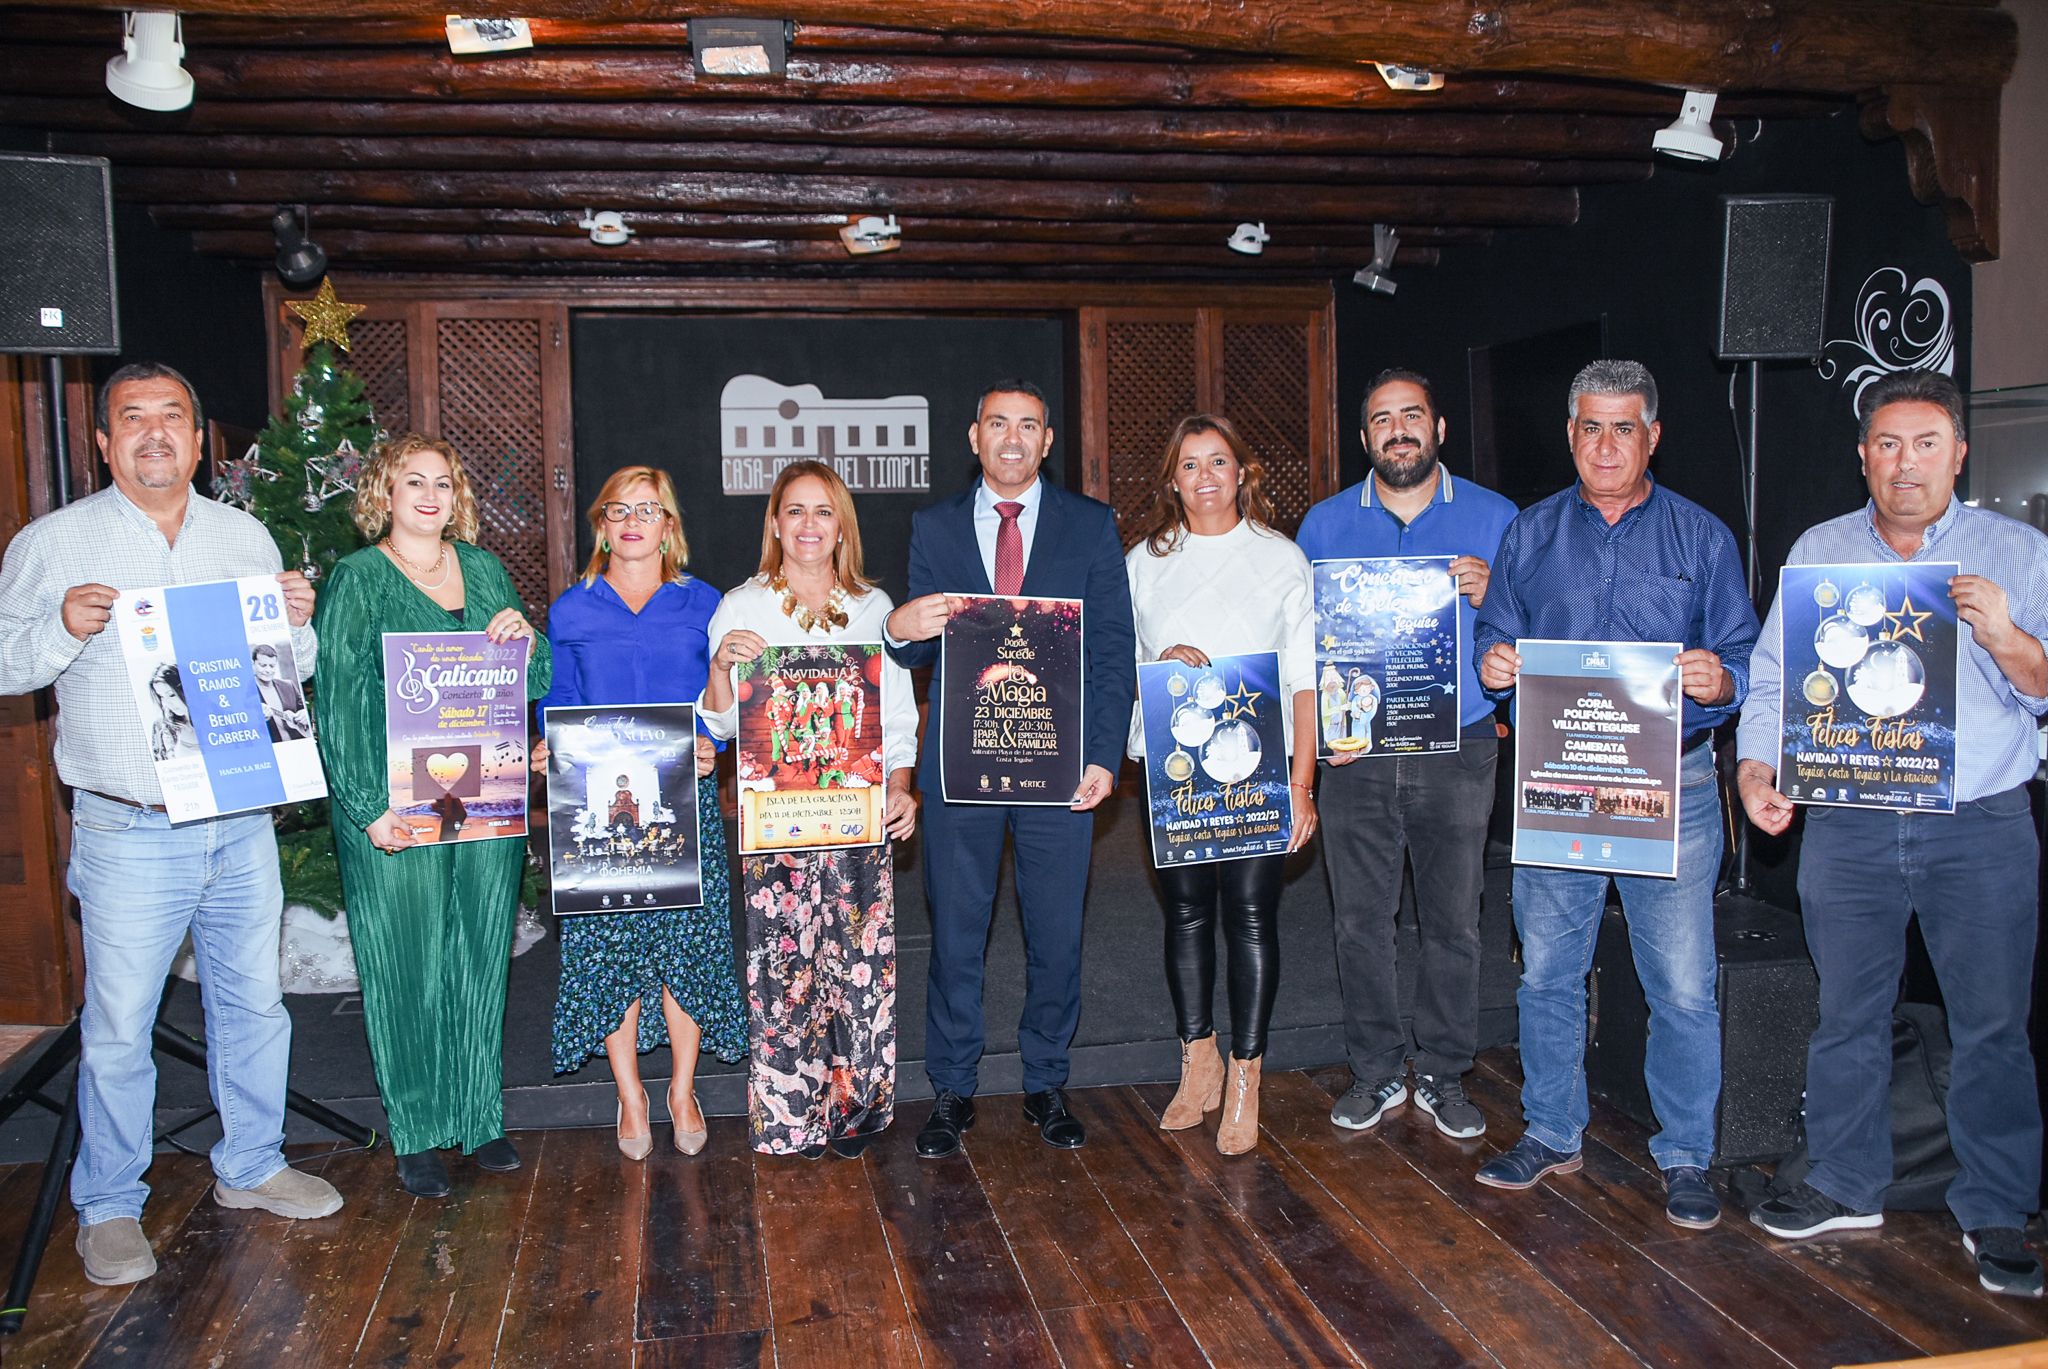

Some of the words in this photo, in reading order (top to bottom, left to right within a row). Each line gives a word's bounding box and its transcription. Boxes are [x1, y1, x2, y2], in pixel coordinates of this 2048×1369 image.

[722, 457, 827, 489] CASA-M
[834, 456, 863, 488] DEL
[867, 456, 930, 488] TIMPLE
[247, 594, 280, 622] 28
[1335, 597, 1353, 614] de
[1392, 615, 1440, 636] Teguise
[1004, 638, 1030, 646] Donde
[1385, 642, 1431, 650] ASOCIACIONES
[486, 648, 518, 661] 2022
[997, 646, 1036, 660] Sucede
[189, 658, 241, 675] CRISTINA
[424, 663, 519, 688] Calicanto
[781, 668, 849, 683] NAVIDALIA
[198, 677, 241, 692] RAMOS
[219, 694, 231, 708] &
[442, 690, 482, 701] Concierto
[481, 687, 496, 701] 10
[495, 689, 514, 699] años
[976, 680, 1047, 708] Magia
[1577, 698, 1615, 709] CORAL
[438, 705, 476, 720] Sábado
[476, 705, 489, 718] 17
[975, 707, 990, 719] 23
[994, 707, 1053, 720] DICIEMBRE
[1563, 707, 1628, 721] POLIFÓNICA
[208, 712, 249, 728] BENITO
[438, 719, 448, 729] de
[449, 717, 487, 727] diciembre
[973, 720, 1000, 729] 17:30h.
[1018, 720, 1056, 732] 20:30h.
[1552, 719, 1581, 731] VILLA
[1582, 721, 1596, 732] DE
[1597, 722, 1641, 734] TEGUISE
[978, 728, 999, 739] PAPÁ
[1000, 719, 1018, 749] &
[1806, 706, 1860, 748] Felices
[1865, 716, 1925, 751] Fiestas
[208, 729, 260, 746] CABRERA
[624, 730, 666, 742] NUEVO
[978, 739, 1001, 748] NOEL
[1017, 739, 1057, 749] FAMILIAR
[1565, 740, 1626, 754] CAMERATA
[1562, 751, 1629, 765] LACUNENSIS
[1796, 752, 1839, 764] NAVIDAD
[1840, 755, 1847, 765] Y
[1850, 755, 1879, 767] REYES
[1895, 756, 1940, 770] 2022/23
[219, 766, 243, 777] HACIA
[243, 764, 254, 772] LA
[1544, 762, 1570, 771] Sábado
[1530, 770, 1552, 778] Iglesia
[1623, 776, 1662, 786] Guadalupe
[1796, 764, 1826, 782] Teguise,
[1828, 766, 1849, 779] Costa
[1852, 767, 1881, 786] Teguise
[1891, 770, 1901, 782] La
[1019, 779, 1047, 788] VÉRTICE
[766, 797, 785, 806] ISLA
[787, 796, 798, 805] DE
[800, 796, 811, 804] LA
[813, 793, 858, 803] GRACIOSA
[1170, 779, 1216, 816] Felices
[1219, 782, 1266, 812] Fiestas
[792, 808, 833, 818] DICIEMBRE
[1166, 818, 1201, 832] NAVIDAD
[1202, 817, 1208, 828] Y
[1209, 815, 1235, 827] REYES
[1246, 809, 1280, 823] 2022/23
[1166, 830, 1193, 847] Teguise,
[1194, 829, 1212, 841] Costa
[1213, 825, 1237, 842] Teguise
[1243, 824, 1253, 834] La
[600, 861, 654, 877] BOHEMIA
